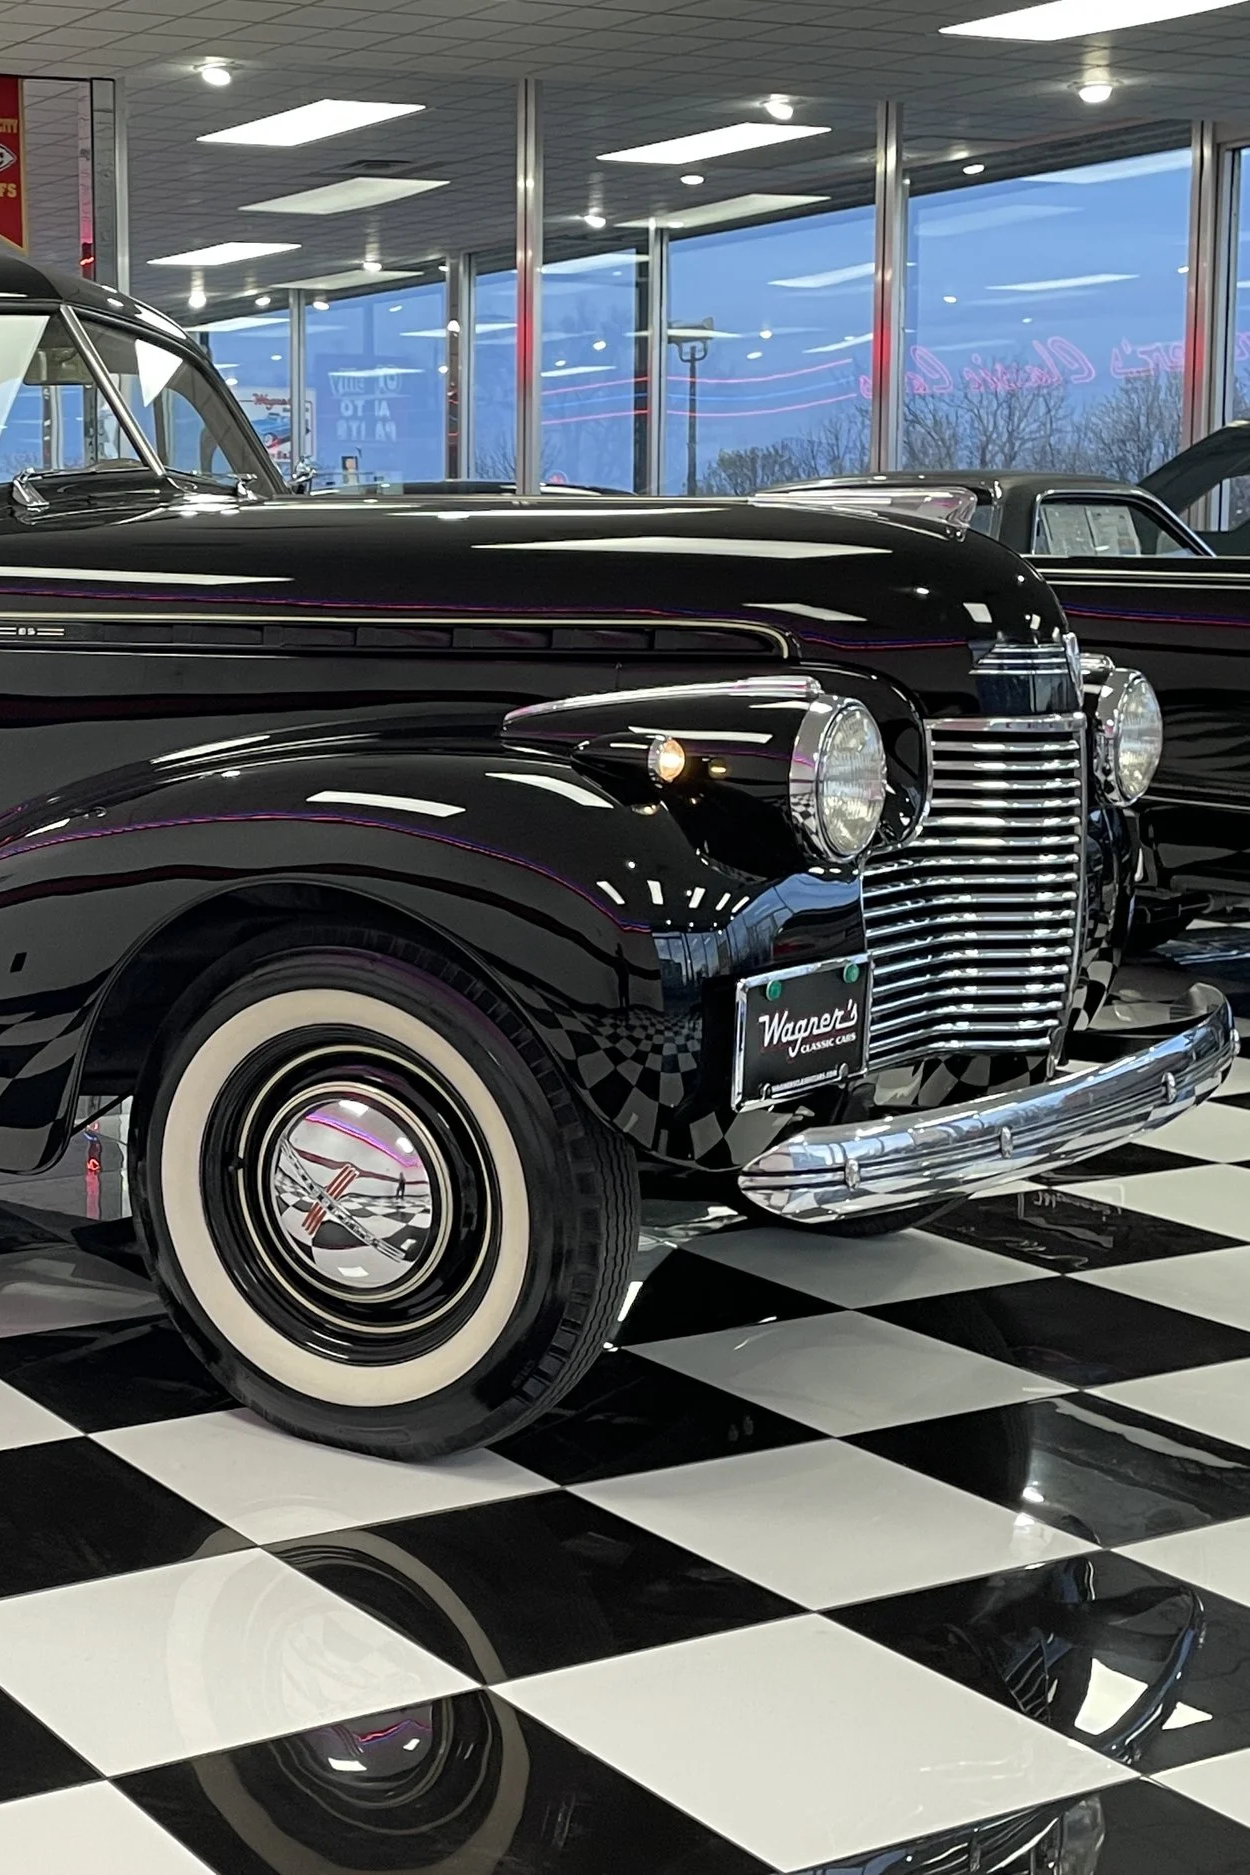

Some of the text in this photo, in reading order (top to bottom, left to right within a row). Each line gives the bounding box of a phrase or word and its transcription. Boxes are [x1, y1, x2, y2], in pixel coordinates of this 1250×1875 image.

[758, 999, 858, 1058] Wagner's
[801, 1032, 857, 1054] CLASSIC CARS
